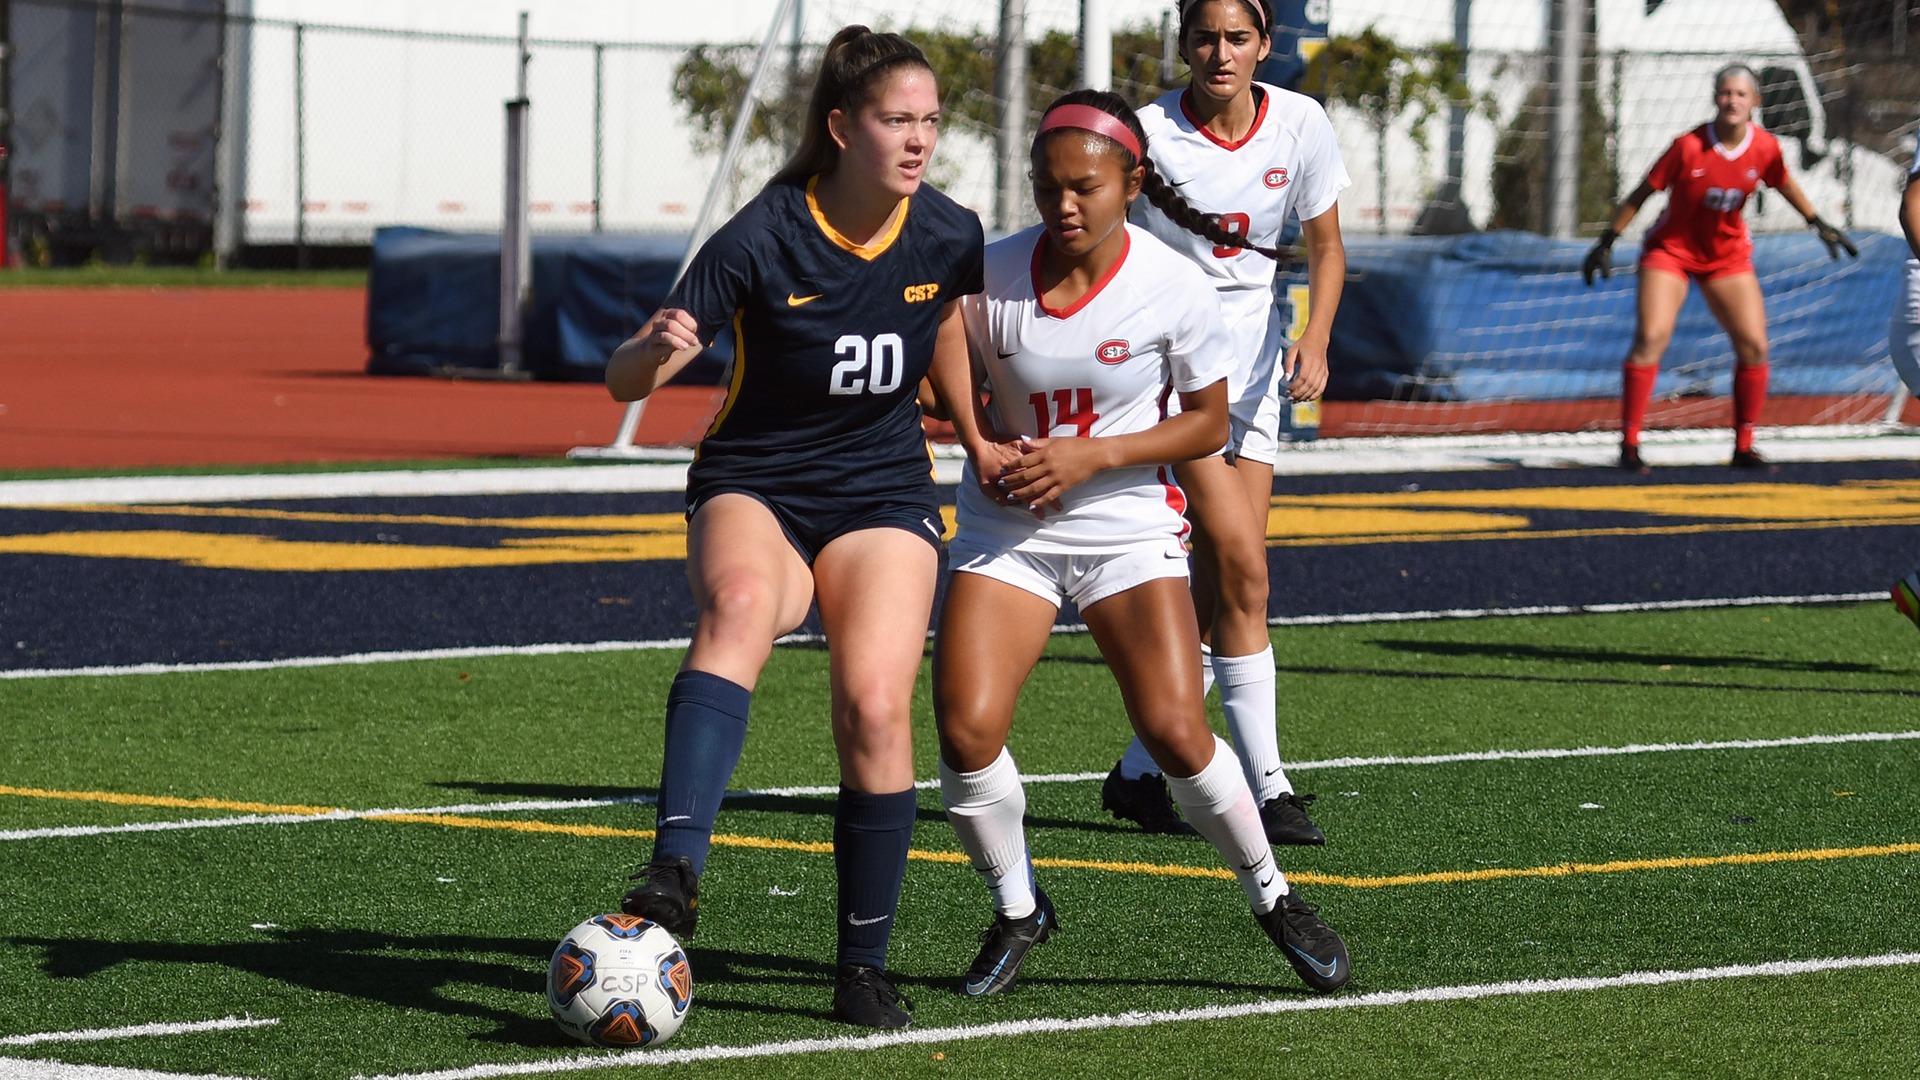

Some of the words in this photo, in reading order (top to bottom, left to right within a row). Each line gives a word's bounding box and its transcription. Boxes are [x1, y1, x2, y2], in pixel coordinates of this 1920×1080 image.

[904, 283, 939, 303] CSP
[829, 333, 904, 395] 20
[1029, 388, 1100, 438] 14
[601, 973, 648, 994] CSP
